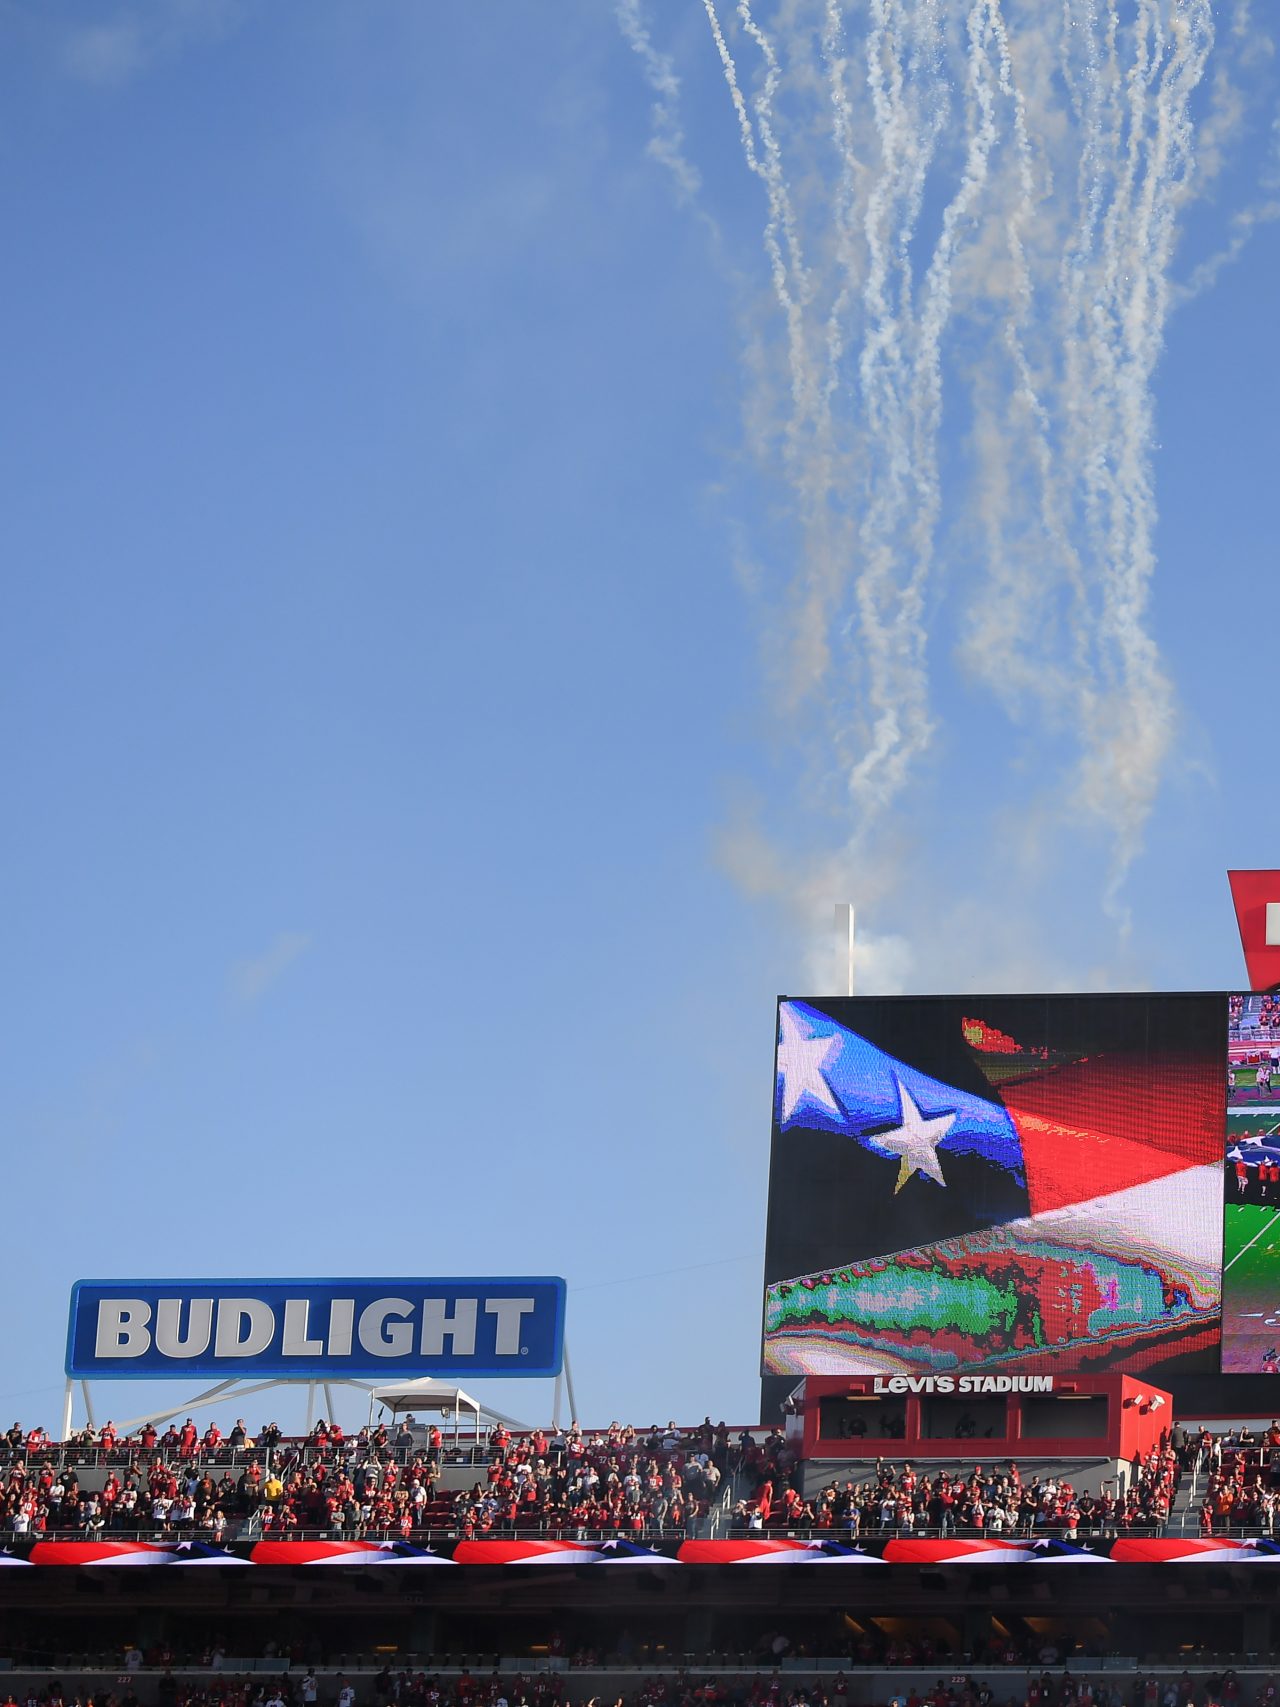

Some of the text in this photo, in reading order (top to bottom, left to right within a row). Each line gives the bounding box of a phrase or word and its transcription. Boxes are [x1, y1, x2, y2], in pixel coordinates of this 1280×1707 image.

[958, 1375, 1053, 1393] STADIUM
[117, 1676, 132, 1684] 227
[951, 1676, 966, 1684] 229
